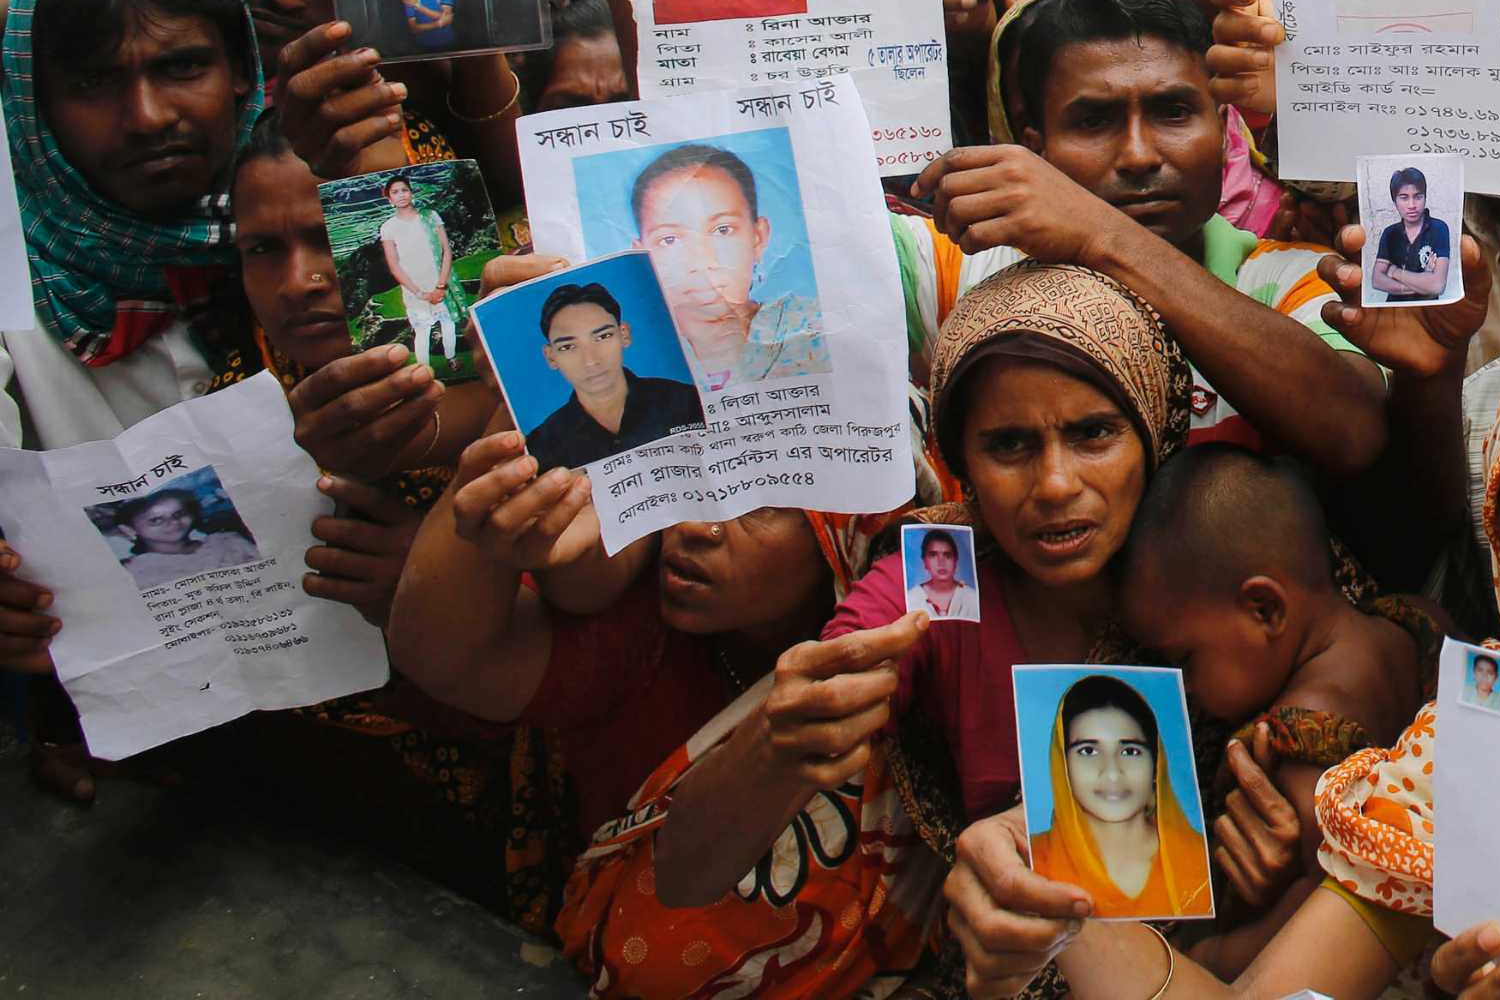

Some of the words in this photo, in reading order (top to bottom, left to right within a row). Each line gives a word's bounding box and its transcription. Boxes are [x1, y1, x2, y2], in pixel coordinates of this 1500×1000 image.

[653, 28, 692, 40] নাম
[759, 18, 799, 32] রিনা
[809, 13, 872, 29] আক্তার
[656, 43, 702, 56] পিতা
[762, 34, 822, 48] কাসেম
[830, 28, 875, 42] আলী
[1303, 44, 1341, 57] মোঃ
[1348, 42, 1413, 59] সাইফুর
[1422, 45, 1480, 57] রহমান
[655, 58, 698, 70] মাতা
[762, 49, 807, 65] রাবেয়া
[811, 44, 850, 60] বেগম
[1291, 61, 1341, 76] পিতাঃ
[1347, 65, 1383, 76] মোঃ
[1388, 65, 1420, 76] আঃ
[1425, 66, 1482, 78] মালেক
[658, 76, 696, 88] গ্রাম
[766, 71, 789, 81] চর
[894, 65, 926, 81] ছিলেন
[735, 93, 792, 121] সন্ধান
[799, 81, 843, 111] চাই
[1298, 81, 1352, 94] আইডি
[1359, 81, 1394, 95] কার্ড
[1292, 100, 1361, 114] মোবাইল
[534, 121, 601, 151] সন্ধান
[608, 110, 651, 140] চাই
[872, 126, 942, 142] ৩৬৫১৬০
[719, 390, 761, 412] লিজা
[768, 382, 821, 401] আক্তার
[602, 452, 633, 477] গ্রামঃ
[679, 441, 707, 458] কাঠি
[708, 438, 737, 452] থানা
[780, 422, 808, 438] কাঠি
[812, 422, 842, 437] জেলা
[96, 473, 150, 497] সন্ধান
[150, 454, 189, 479] চাই
[609, 471, 645, 499] রানা
[708, 449, 780, 477] গার্মেন্টস
[786, 446, 813, 462] এর
[819, 444, 894, 463] অপারেটর
[617, 491, 678, 526] মোবাইলঃ
